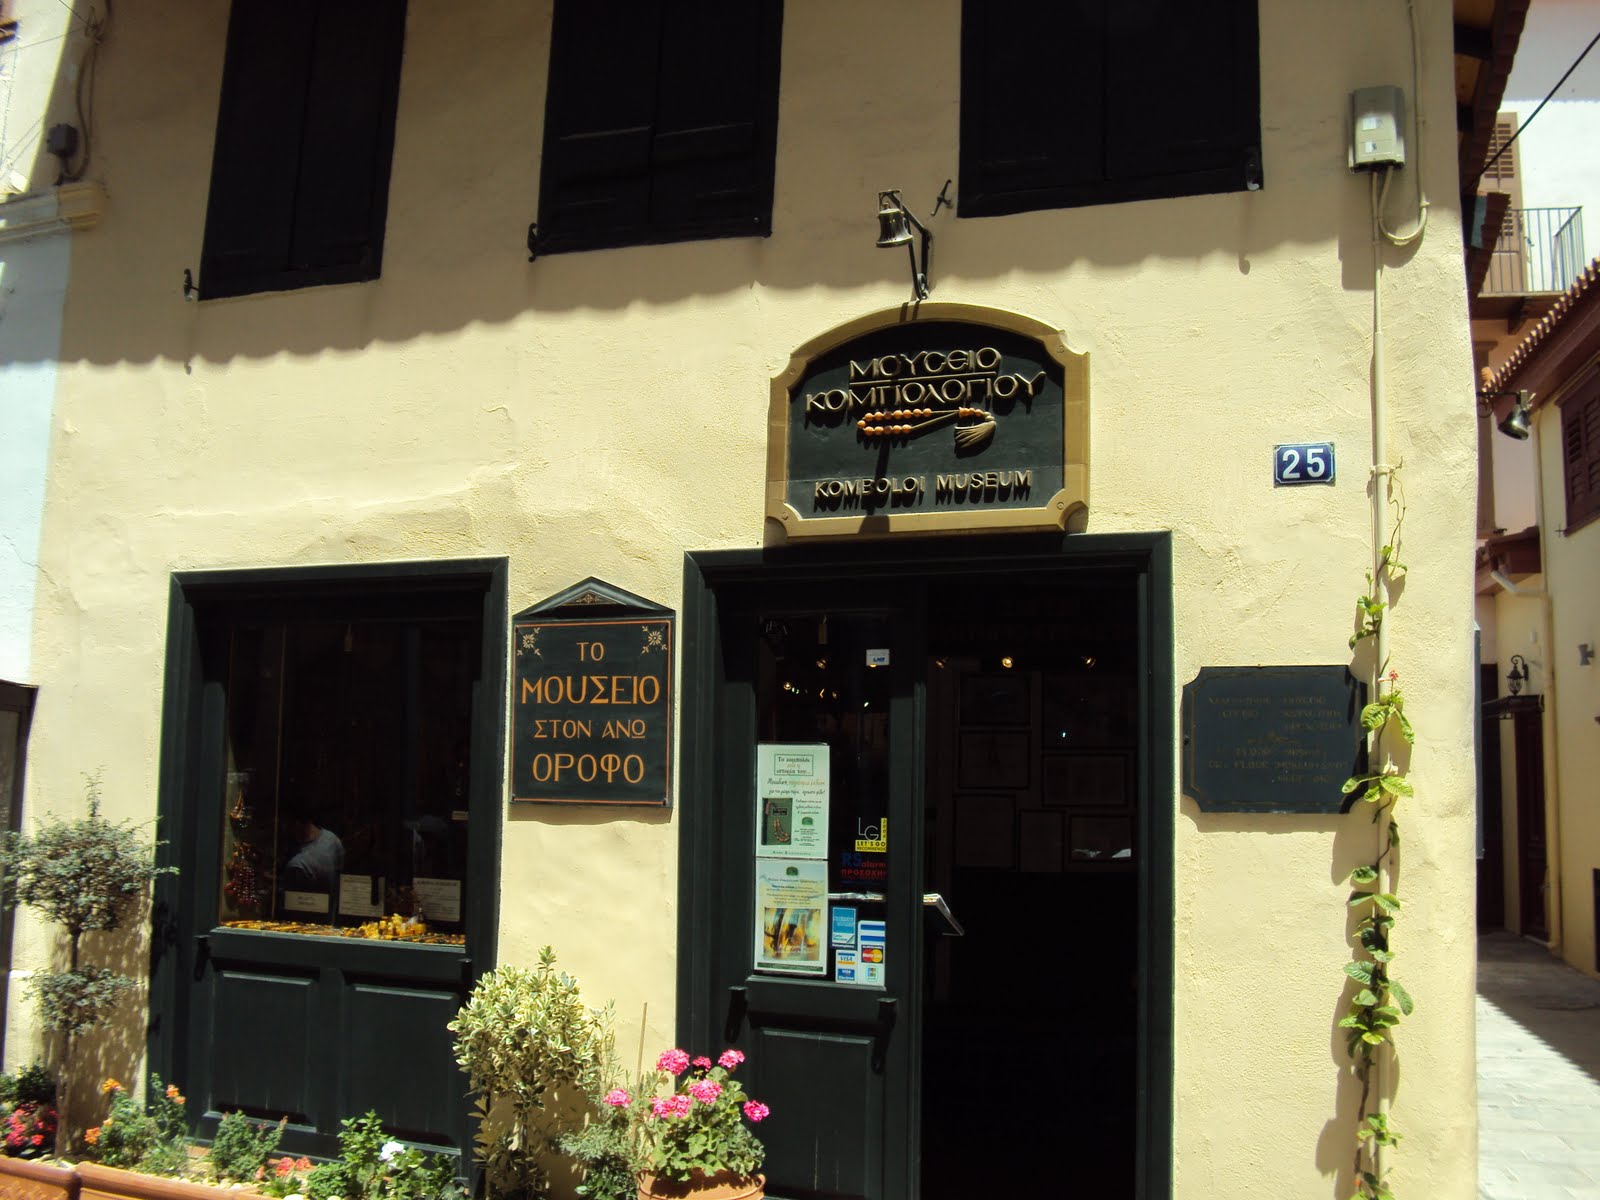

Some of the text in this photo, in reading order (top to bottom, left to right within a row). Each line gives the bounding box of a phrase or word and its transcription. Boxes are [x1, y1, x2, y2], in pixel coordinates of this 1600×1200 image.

[806, 371, 1046, 413] ΚΟΜΠΟΛΟΓΙΟΥ
[1282, 448, 1325, 479] 25
[814, 470, 1032, 498] KOMBOLOI MUSEUM
[576, 641, 605, 662] ΤΟ
[534, 719, 647, 739] ΣΤΟΝ ΑΝΩ
[532, 753, 645, 784] ΟΡΟΦΟ
[861, 860, 886, 868] alarm
